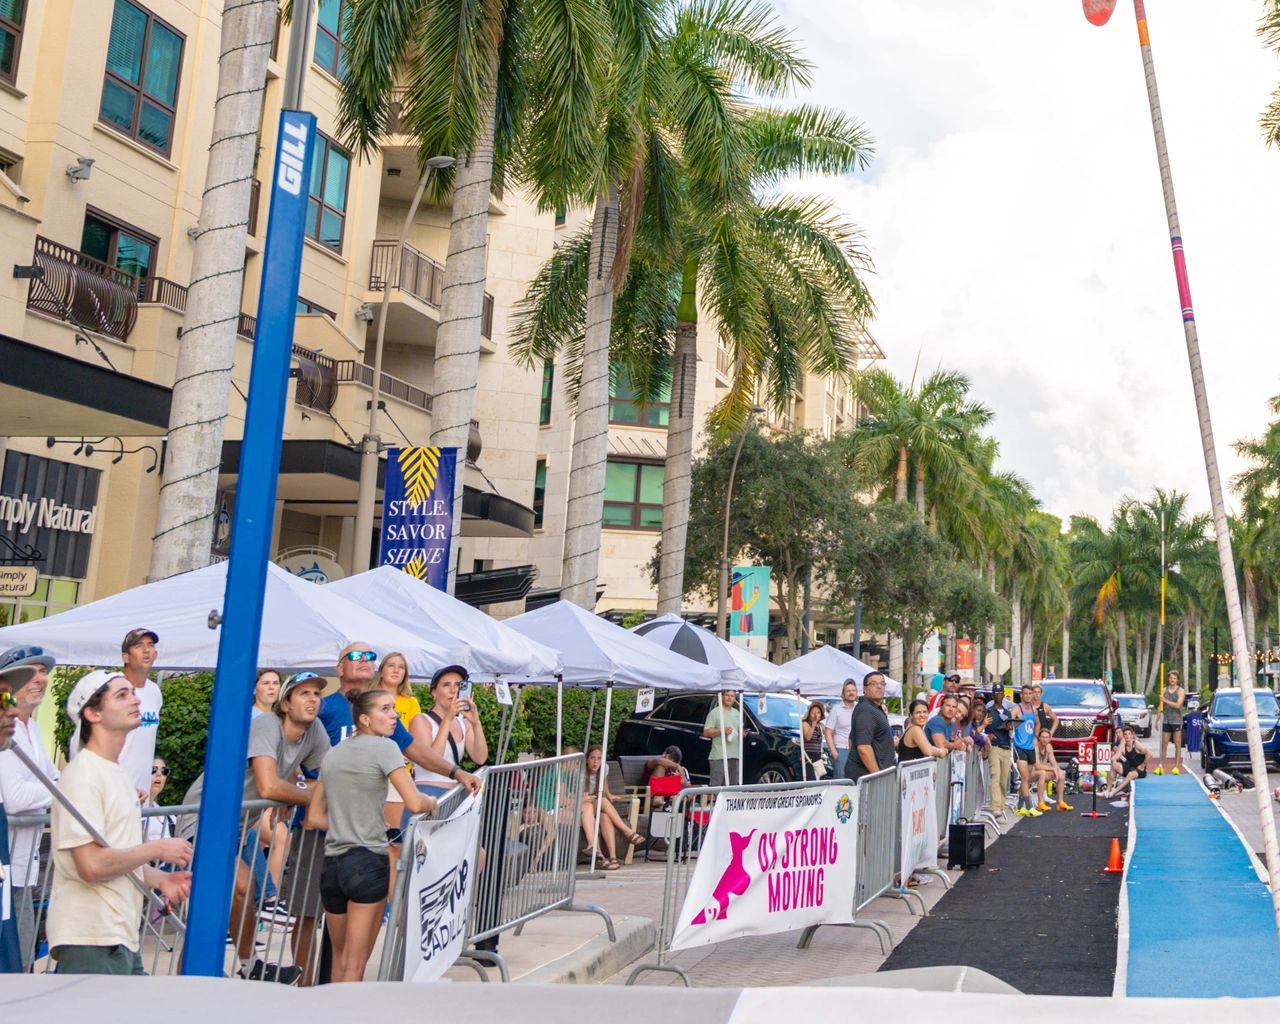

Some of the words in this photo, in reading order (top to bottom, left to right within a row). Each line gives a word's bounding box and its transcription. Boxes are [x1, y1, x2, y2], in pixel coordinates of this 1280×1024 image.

[278, 122, 308, 196] GILL
[37, 496, 98, 534] Natural
[388, 500, 448, 517] STYLE.
[387, 524, 446, 540] SAVOR
[384, 547, 444, 565] SHINE
[0, 570, 27, 583] imply
[1097, 748, 1110, 761] 00
[726, 798, 746, 811] THANK
[745, 798, 758, 810] YOU
[757, 798, 767, 810] TO
[765, 797, 778, 809] OUR
[777, 796, 796, 808] GREAT
[781, 826, 838, 869] STRONG
[767, 868, 824, 913] MOVING
